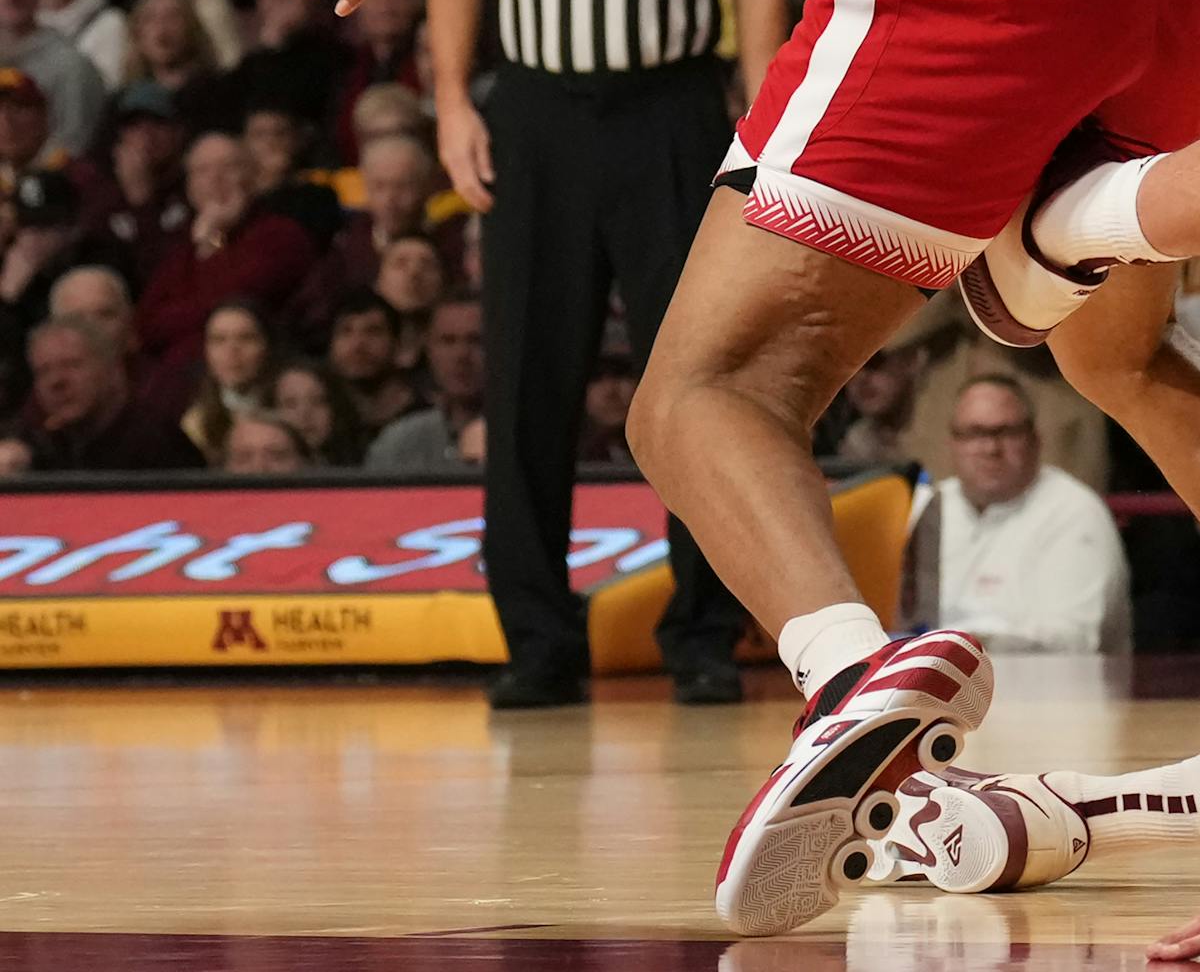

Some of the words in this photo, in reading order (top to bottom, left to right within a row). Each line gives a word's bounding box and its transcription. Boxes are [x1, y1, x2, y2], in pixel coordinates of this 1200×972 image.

[0, 609, 87, 637] EALTH
[212, 610, 268, 651] M
[272, 607, 372, 632] HEALTH
